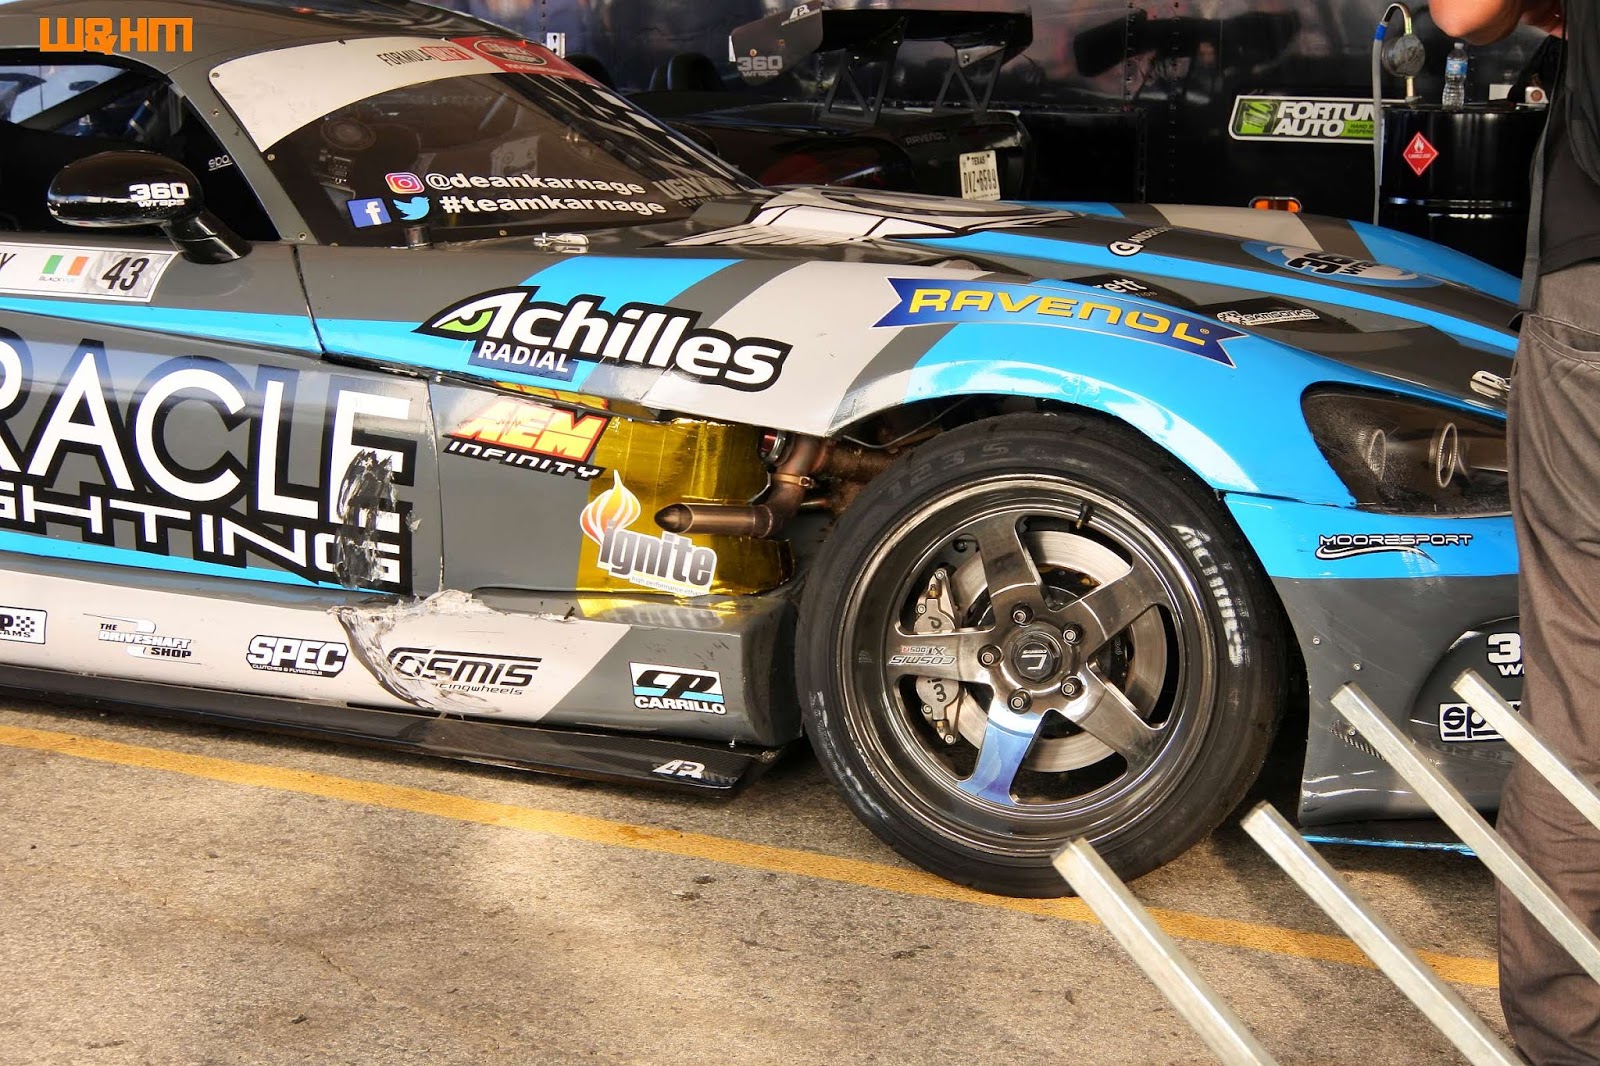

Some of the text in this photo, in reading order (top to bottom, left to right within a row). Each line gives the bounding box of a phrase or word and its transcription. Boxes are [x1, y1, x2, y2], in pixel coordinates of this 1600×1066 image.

[737, 56, 783, 71] 360
[1272, 119, 1345, 137] AUTO
[971, 156, 985, 166] TEXAS
[129, 182, 190, 200] 360
[426, 173, 646, 195] @deankarnage
[137, 199, 186, 207] wraps
[440, 195, 666, 216] #teamkarnage
[102, 257, 149, 291] 43
[909, 288, 1206, 346] RAVENOL
[432, 292, 784, 385] Achilles
[478, 341, 570, 373] RADIAL
[453, 400, 607, 460] AEM
[450, 441, 600, 477] INFINITY
[0, 481, 400, 583] HTING
[1319, 534, 1472, 546] MOORESPORT
[601, 520, 715, 586] ignite
[100, 623, 118, 631] THE
[98, 630, 192, 650] DRIVESHAFT
[151, 647, 192, 658] SHOP
[246, 635, 348, 673] SPEC
[888, 655, 956, 666] COSMIS
[252, 664, 283, 672] CLUTCHES
[387, 647, 542, 687] COSMIS
[433, 682, 524, 696] cingwheels
[636, 670, 717, 699] CP
[634, 696, 727, 715] CARRILLO
